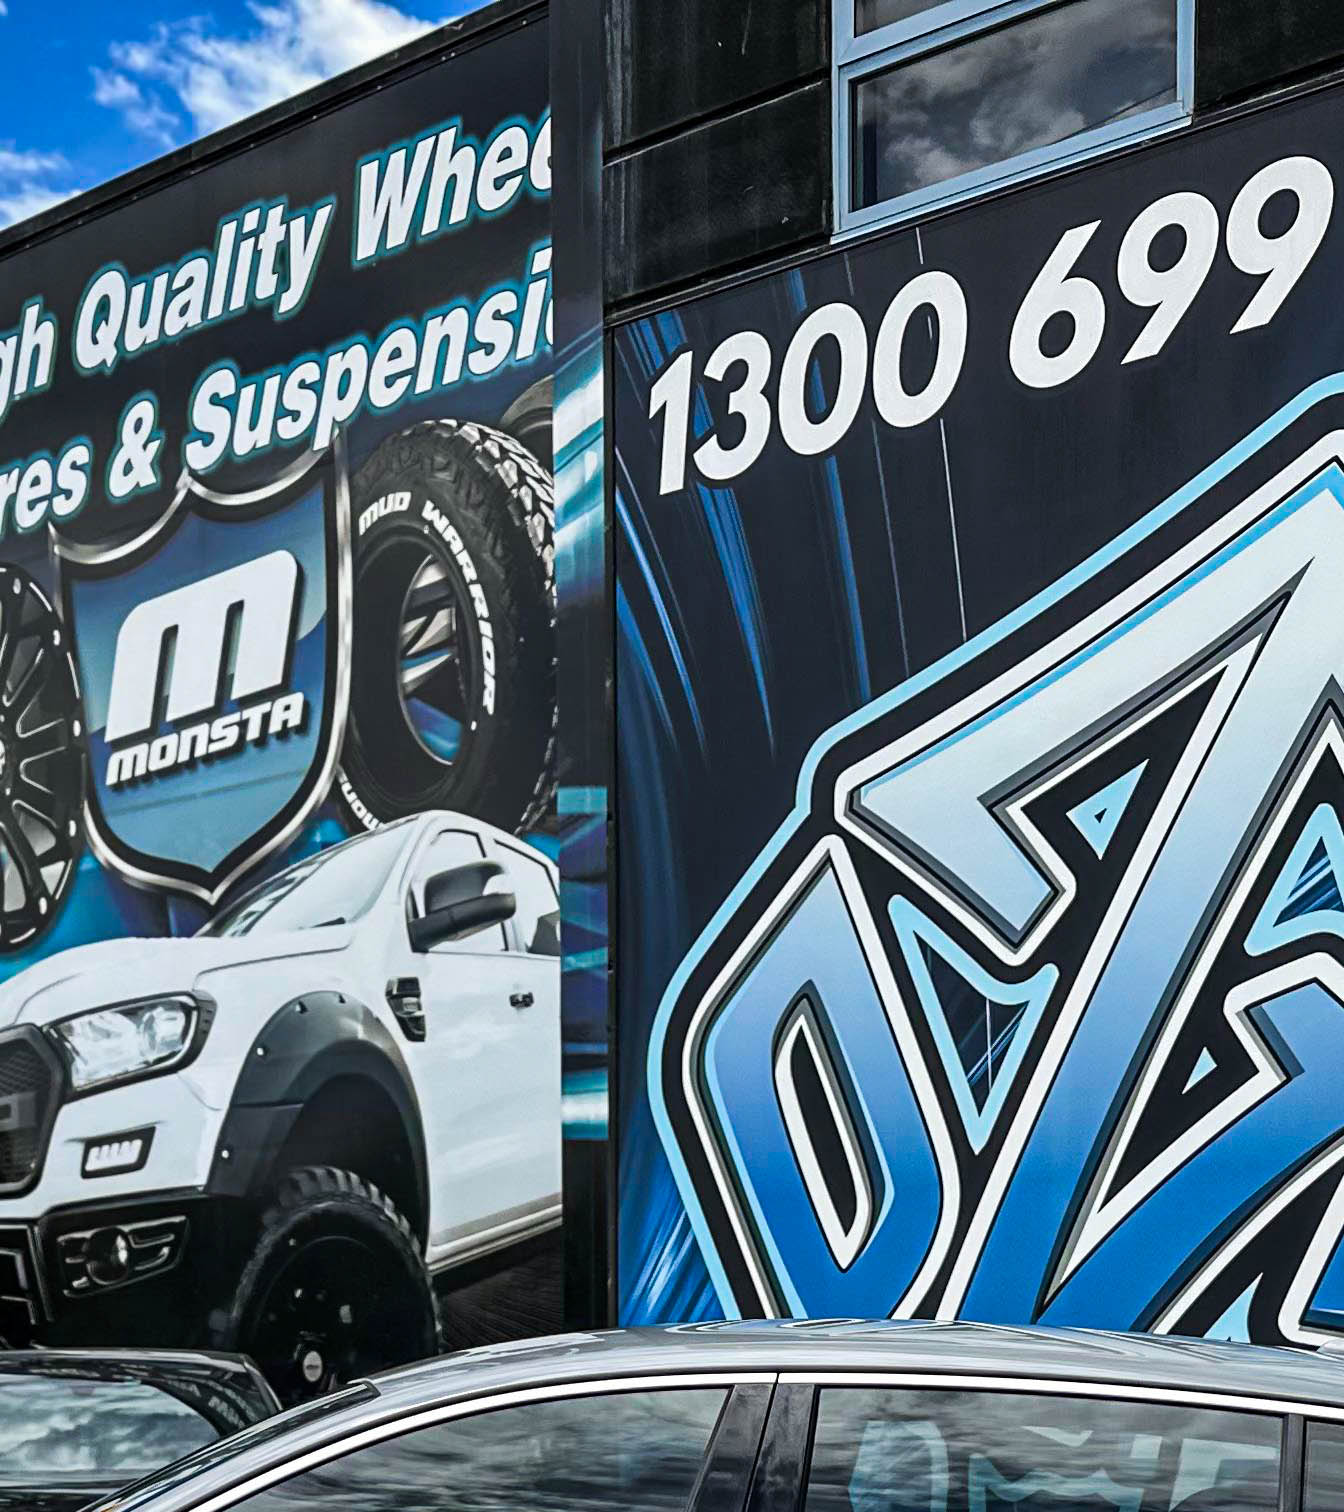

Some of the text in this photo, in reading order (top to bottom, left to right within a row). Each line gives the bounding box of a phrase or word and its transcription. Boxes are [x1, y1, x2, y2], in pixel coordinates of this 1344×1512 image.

[76, 201, 332, 374] Quality
[110, 399, 163, 498] &
[186, 247, 554, 473] Suspensi
[648, 270, 967, 495] 1300
[1009, 155, 1335, 389] 699
[358, 491, 496, 716] MUD WARRIOR
[105, 692, 305, 787] MONSTA
